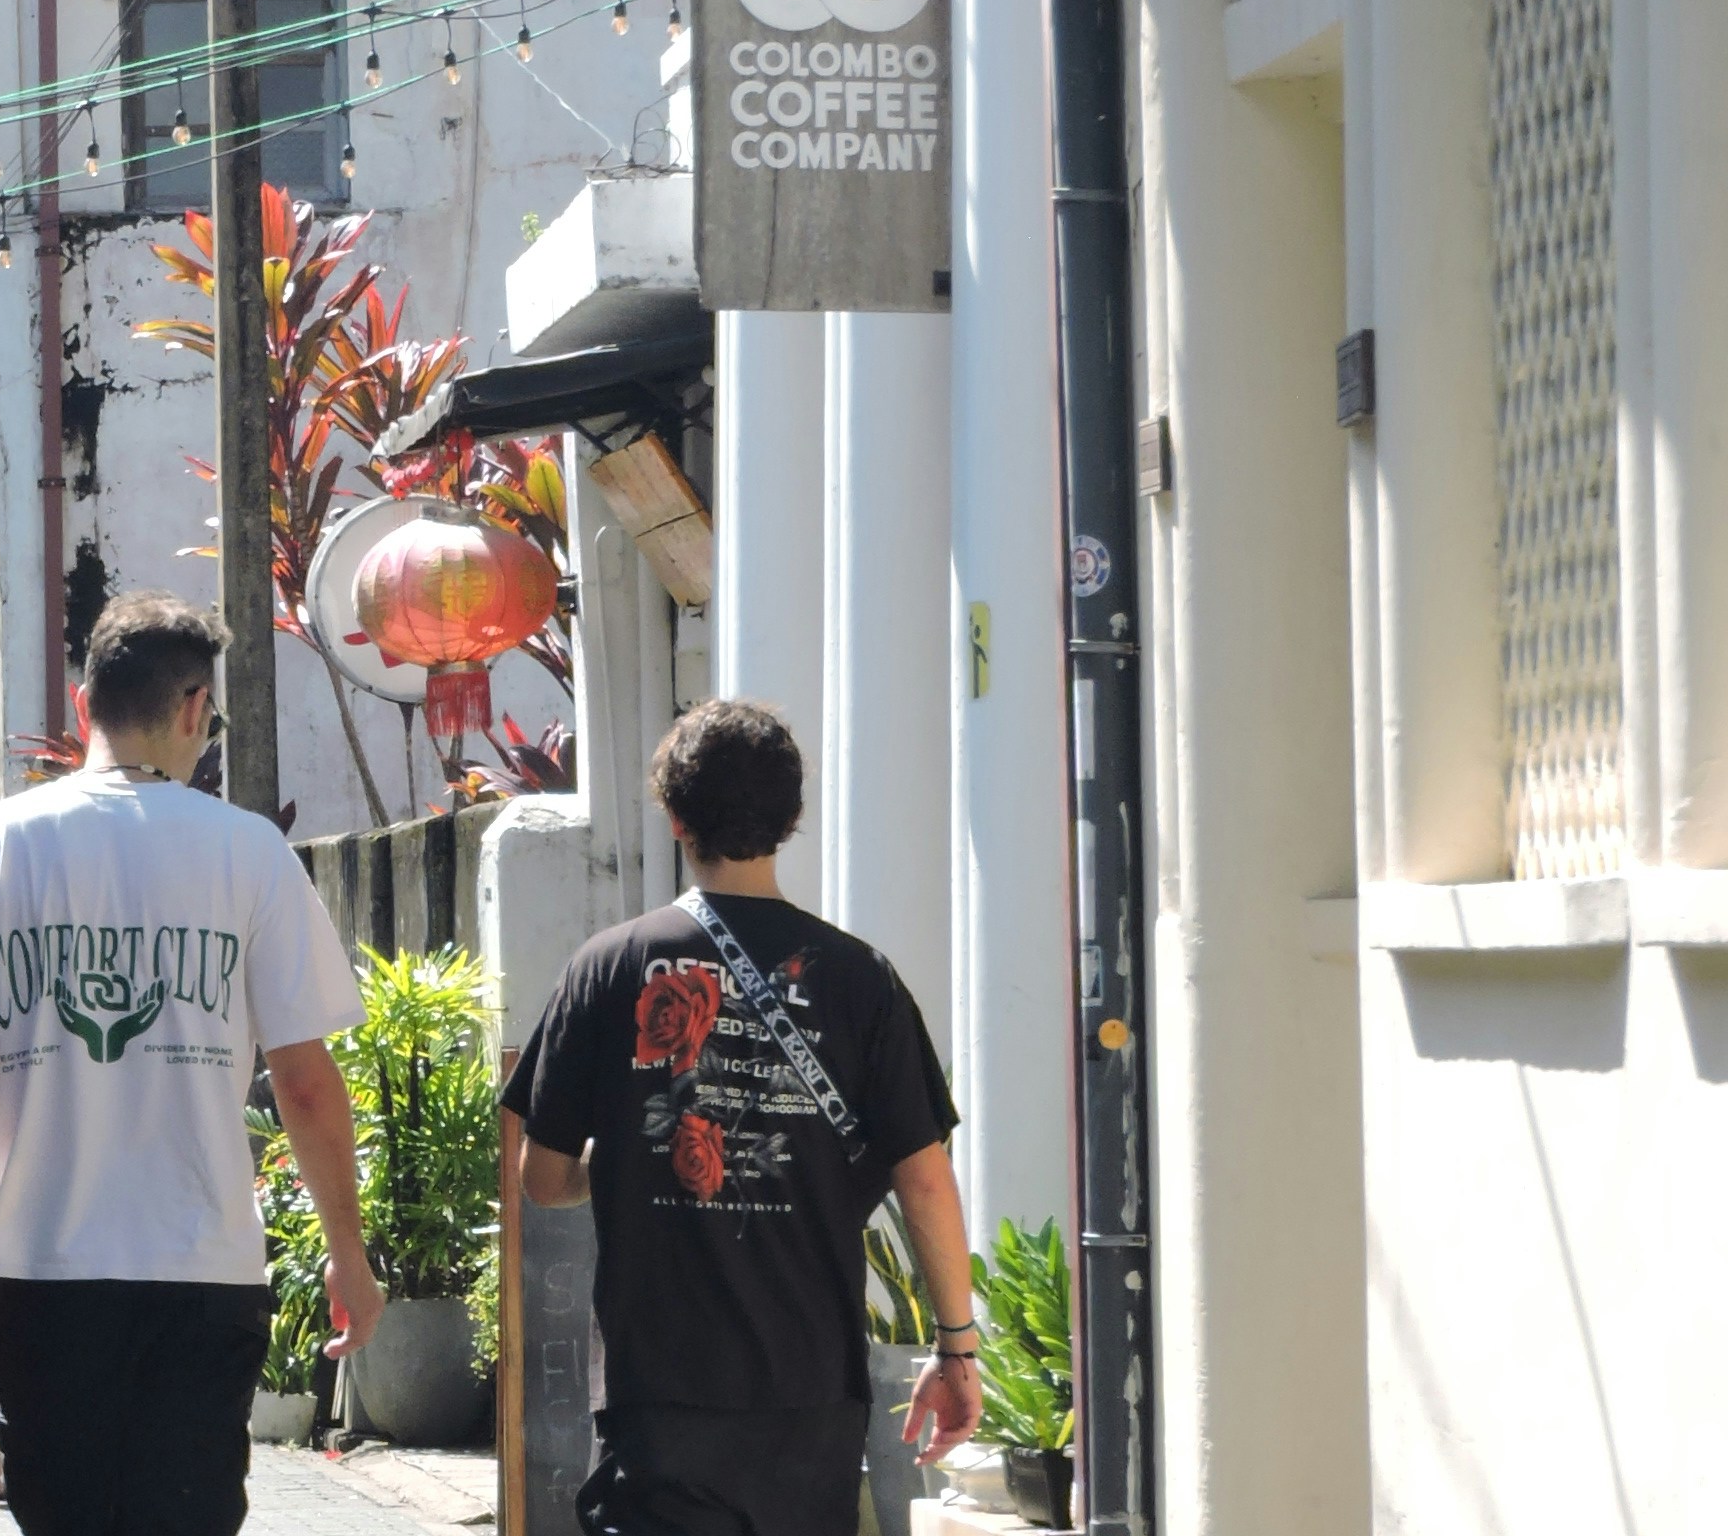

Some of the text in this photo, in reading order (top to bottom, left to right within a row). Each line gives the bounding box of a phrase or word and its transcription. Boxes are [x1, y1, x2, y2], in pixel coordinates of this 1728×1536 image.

[729, 41, 936, 79] COLOMBO
[730, 81, 938, 130] COFFEE
[730, 131, 937, 172] COMPANY
[166, 1055, 199, 1064] LOVED
[782, 1031, 824, 1085] KANI
